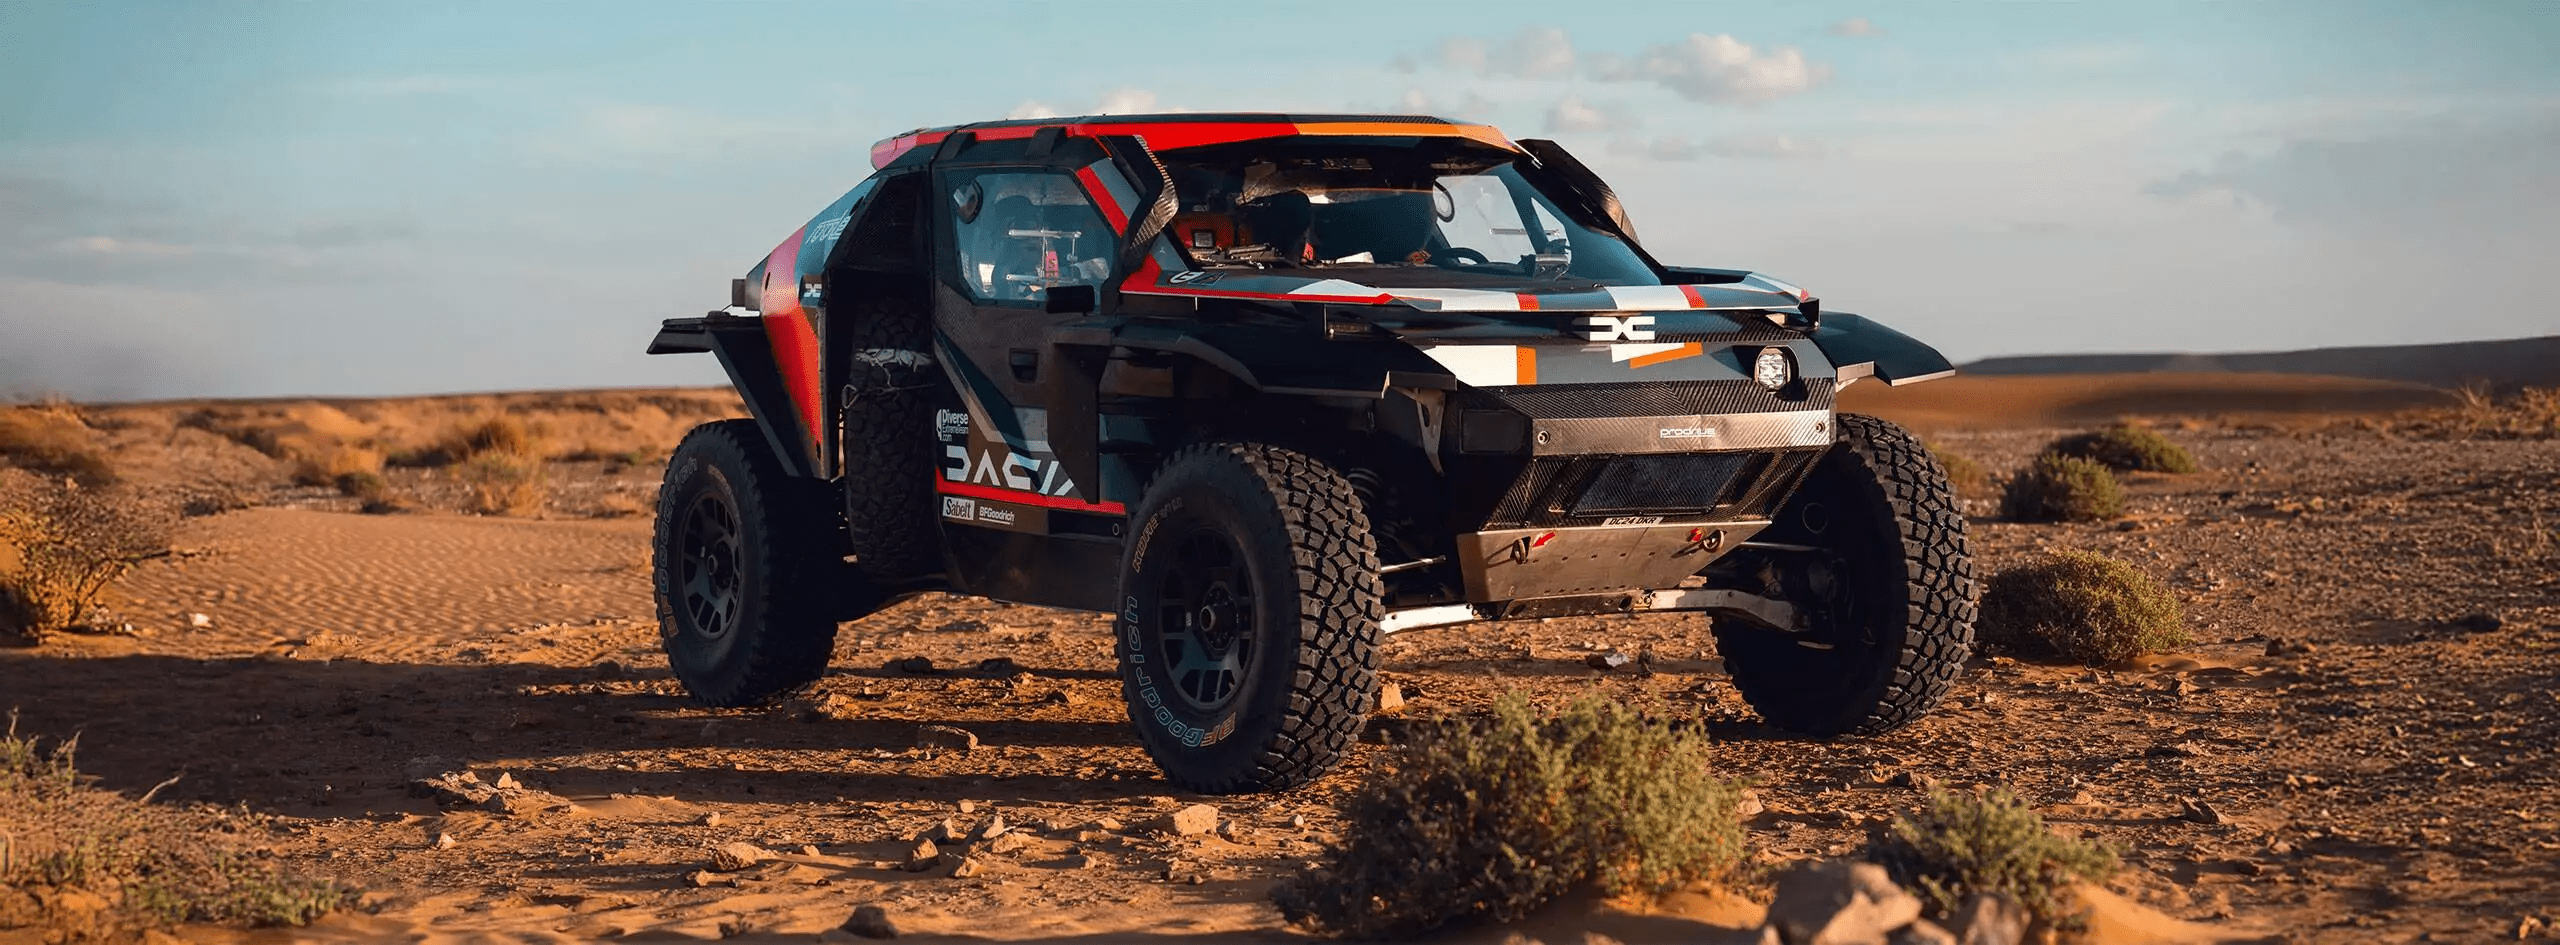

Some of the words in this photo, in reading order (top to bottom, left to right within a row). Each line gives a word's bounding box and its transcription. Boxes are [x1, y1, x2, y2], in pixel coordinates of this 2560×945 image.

[942, 408, 969, 425] Diverse
[945, 498, 971, 518] Sabelt
[979, 506, 1015, 522] BFGoodrich
[1608, 517, 1634, 525] DC24
[1635, 516, 1657, 525] DKR
[1124, 595, 1237, 748] BFGoodrich
